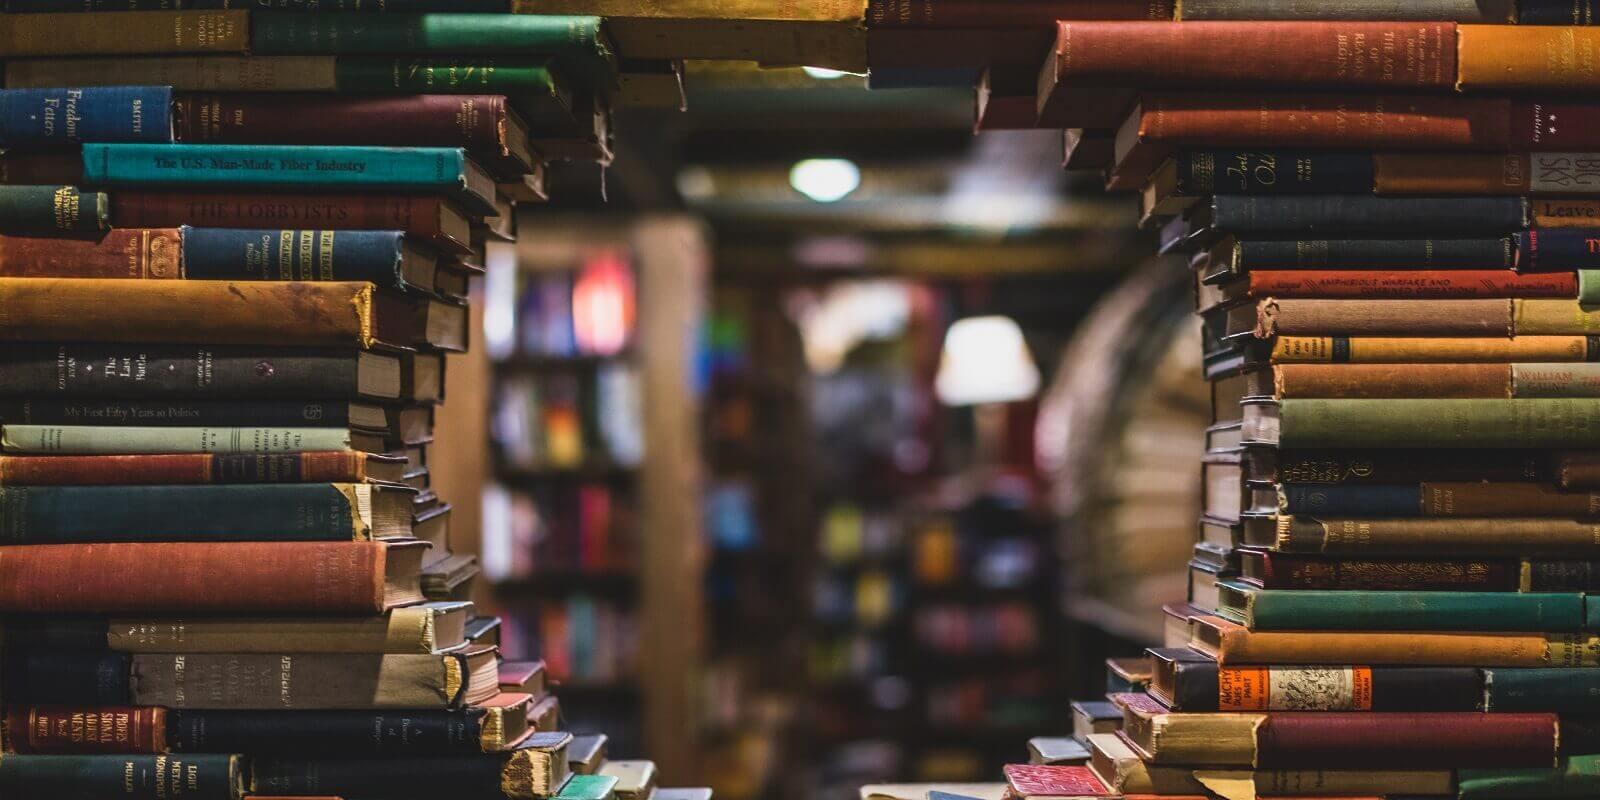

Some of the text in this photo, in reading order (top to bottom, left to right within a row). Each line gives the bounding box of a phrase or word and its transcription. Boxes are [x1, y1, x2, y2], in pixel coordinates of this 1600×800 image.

[1337, 33, 1348, 76] BEGINS
[1354, 33, 1365, 79] REASON
[1370, 47, 1379, 64] OF
[1383, 31, 1395, 80] THE AGE
[132, 99, 142, 133] SMITH
[1336, 105, 1346, 136] WAR
[1532, 104, 1542, 143] Doubleday
[154, 158, 366, 174] The U.S. Man-Made Fiber Industry
[54, 189, 63, 229] COLUMBIA
[187, 202, 350, 222] THE LOBBYISTS
[303, 234, 312, 251] AND
[324, 234, 333, 250] THE
[1319, 279, 1378, 287] AMPHIBIOUS
[1382, 279, 1427, 287] WARFARE
[1430, 279, 1451, 287] AND
[105, 357, 117, 379] The
[120, 357, 131, 379] Last
[136, 353, 147, 382] Battle
[64, 406, 79, 419] My
[83, 405, 105, 417] First
[105, 405, 127, 420] Fifty
[131, 405, 155, 417] Years
[168, 405, 199, 417] Politics
[1221, 669, 1232, 705] ARCHY
[1243, 677, 1252, 699] PART
[72, 712, 84, 743] MENTS
[101, 713, 114, 743] SIONAL
[125, 762, 134, 794] MULLER
[154, 755, 167, 800] MONOPOLY
[172, 761, 182, 796] METALS
[187, 764, 198, 792] LIGHT
